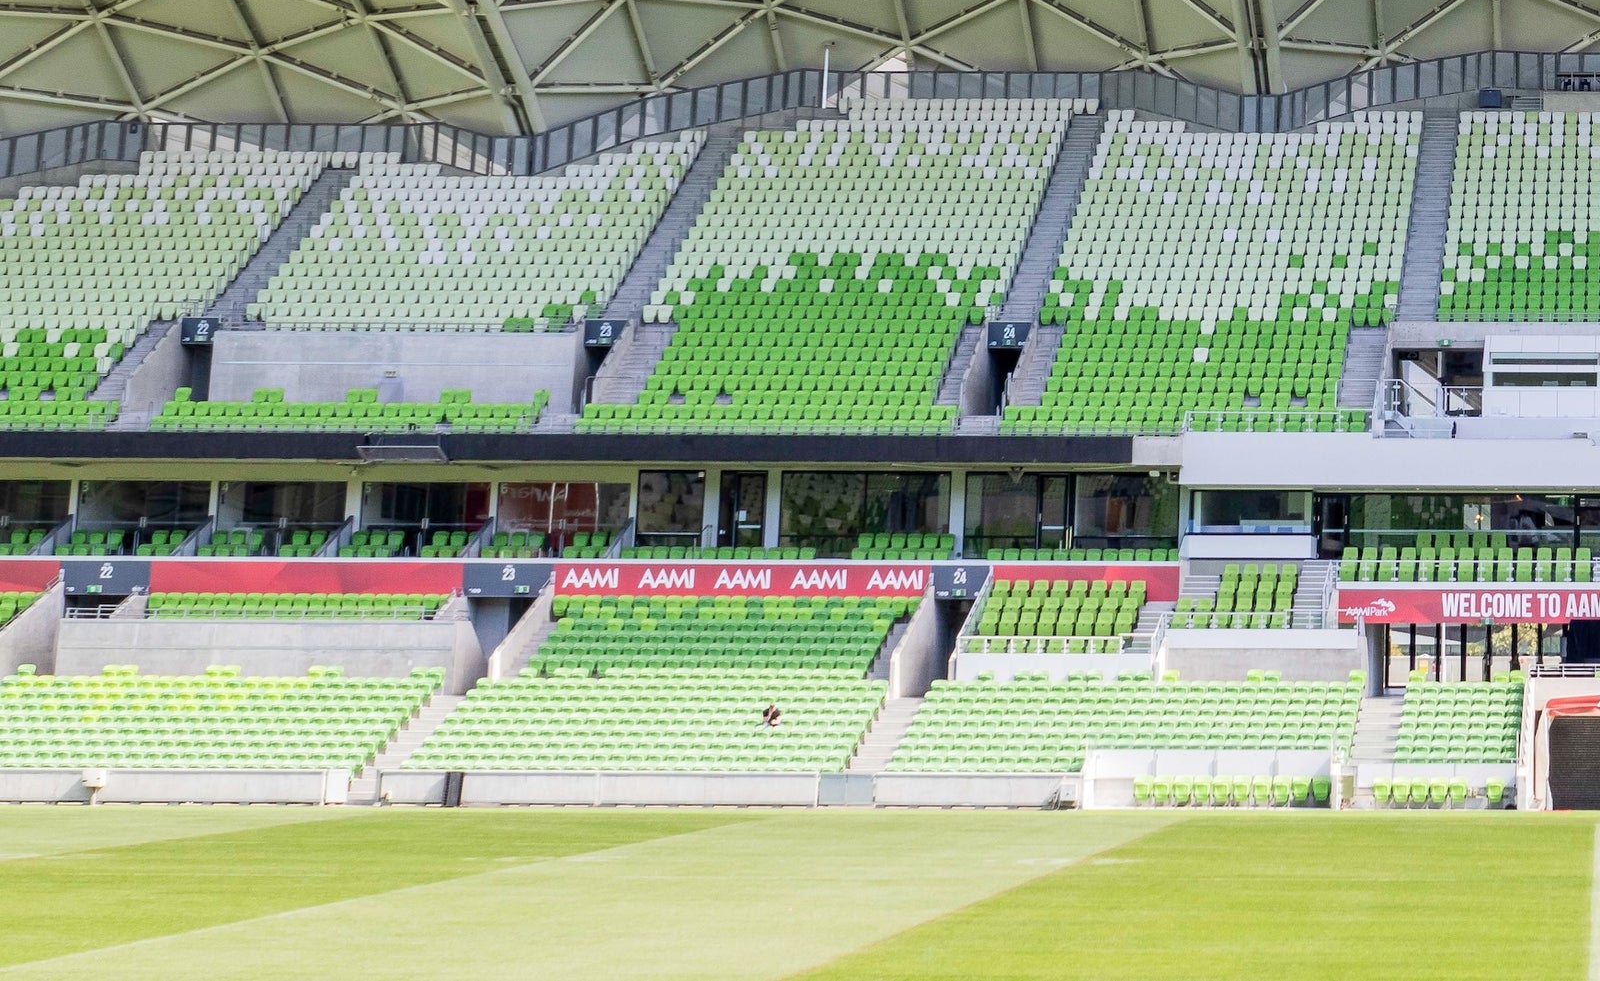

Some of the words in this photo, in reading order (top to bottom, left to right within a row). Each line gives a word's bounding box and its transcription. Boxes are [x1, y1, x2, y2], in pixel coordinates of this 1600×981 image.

[197, 323, 209, 335] 22
[600, 325, 612, 337] 23
[1003, 327, 1016, 339] 24
[100, 566, 113, 578] 22
[502, 567, 516, 580] 23
[562, 568, 619, 588] AAMI
[637, 568, 696, 589] AAMI
[714, 569, 772, 589] AAMI
[789, 569, 848, 590] AAMI
[865, 570, 924, 590] AAMI
[953, 571, 967, 584] 24
[1441, 593, 1533, 618] WELCOME
[1537, 593, 1561, 617] TO
